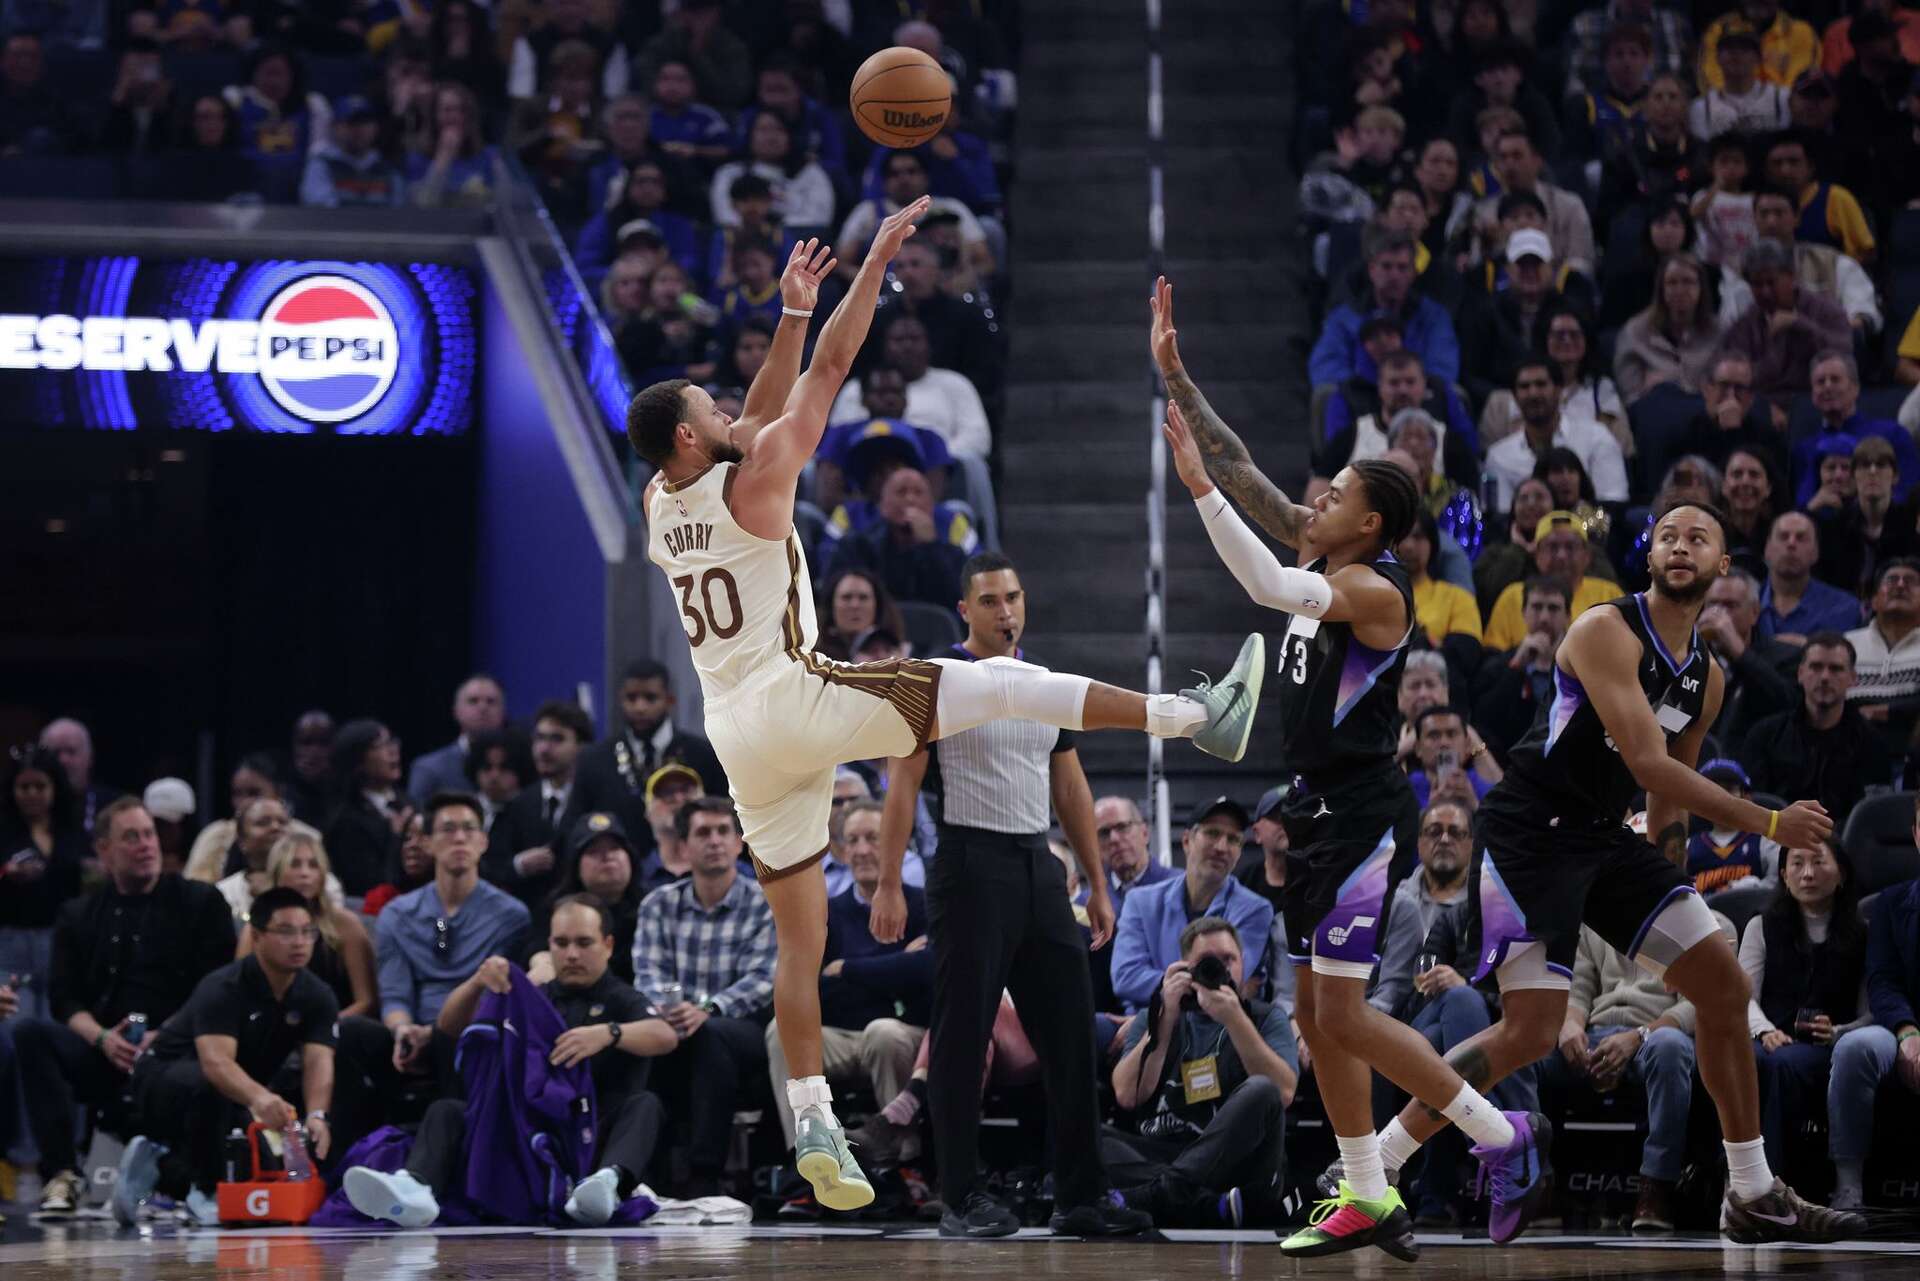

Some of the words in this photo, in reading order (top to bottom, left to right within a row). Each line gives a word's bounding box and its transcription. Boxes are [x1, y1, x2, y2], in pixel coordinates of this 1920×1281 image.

[883, 109, 944, 128] Wilson
[270, 336, 383, 360] PEPSI
[664, 523, 713, 558] CURRY
[673, 567, 743, 647] 30
[1682, 675, 1700, 693] LVT
[1568, 1172, 1641, 1193] CHAS
[246, 1189, 269, 1216] G
